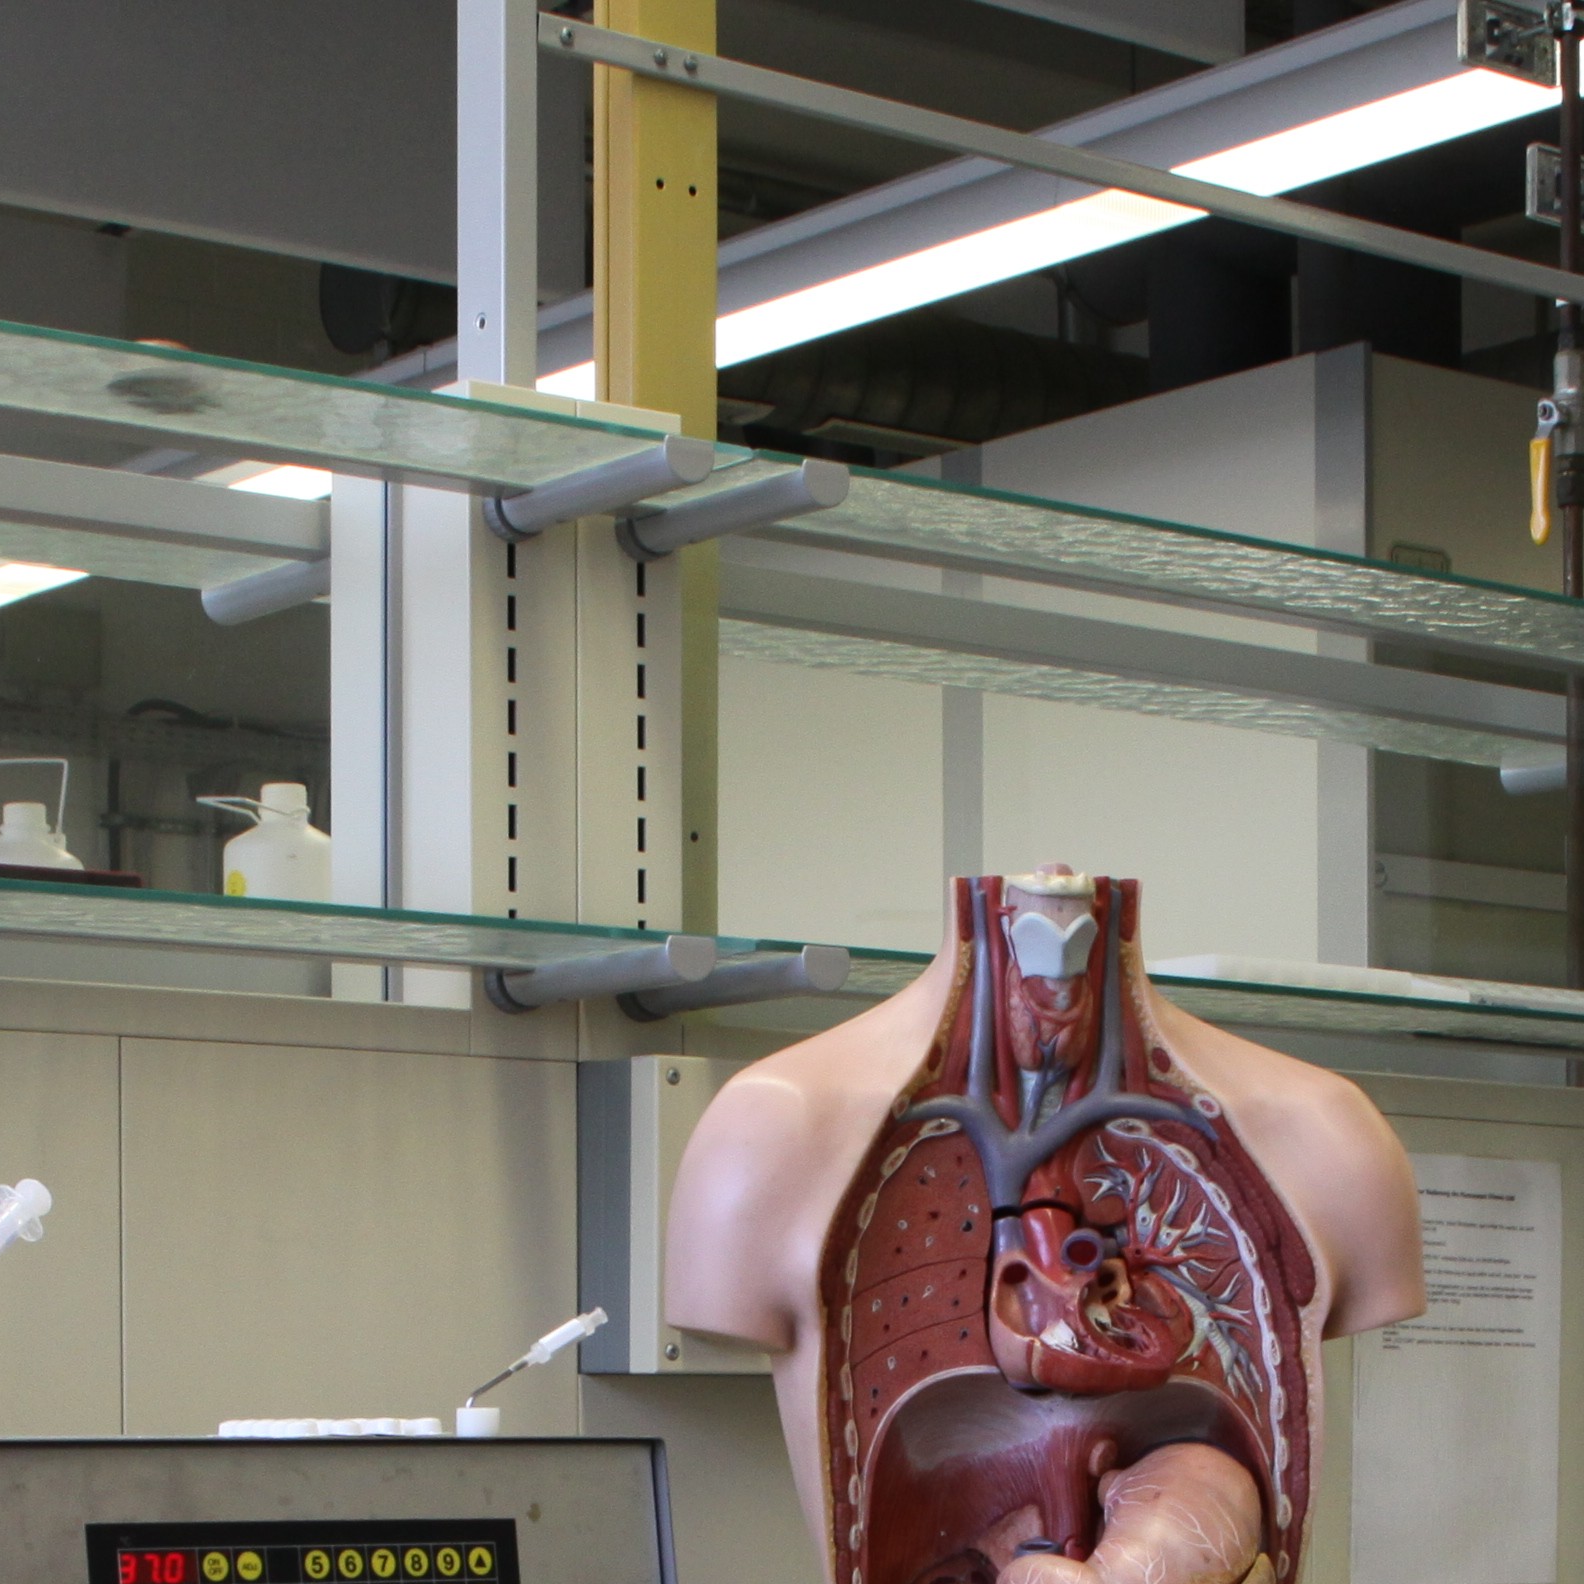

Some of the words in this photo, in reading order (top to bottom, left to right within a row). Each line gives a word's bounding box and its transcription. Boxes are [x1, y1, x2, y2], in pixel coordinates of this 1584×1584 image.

[208, 1558, 220, 1566] ON
[312, 1555, 323, 1575] 5
[345, 1554, 356, 1574] 6
[378, 1554, 389, 1573] 7
[411, 1553, 422, 1573] 8
[443, 1552, 454, 1572] 9
[208, 1568, 222, 1576] OFF
